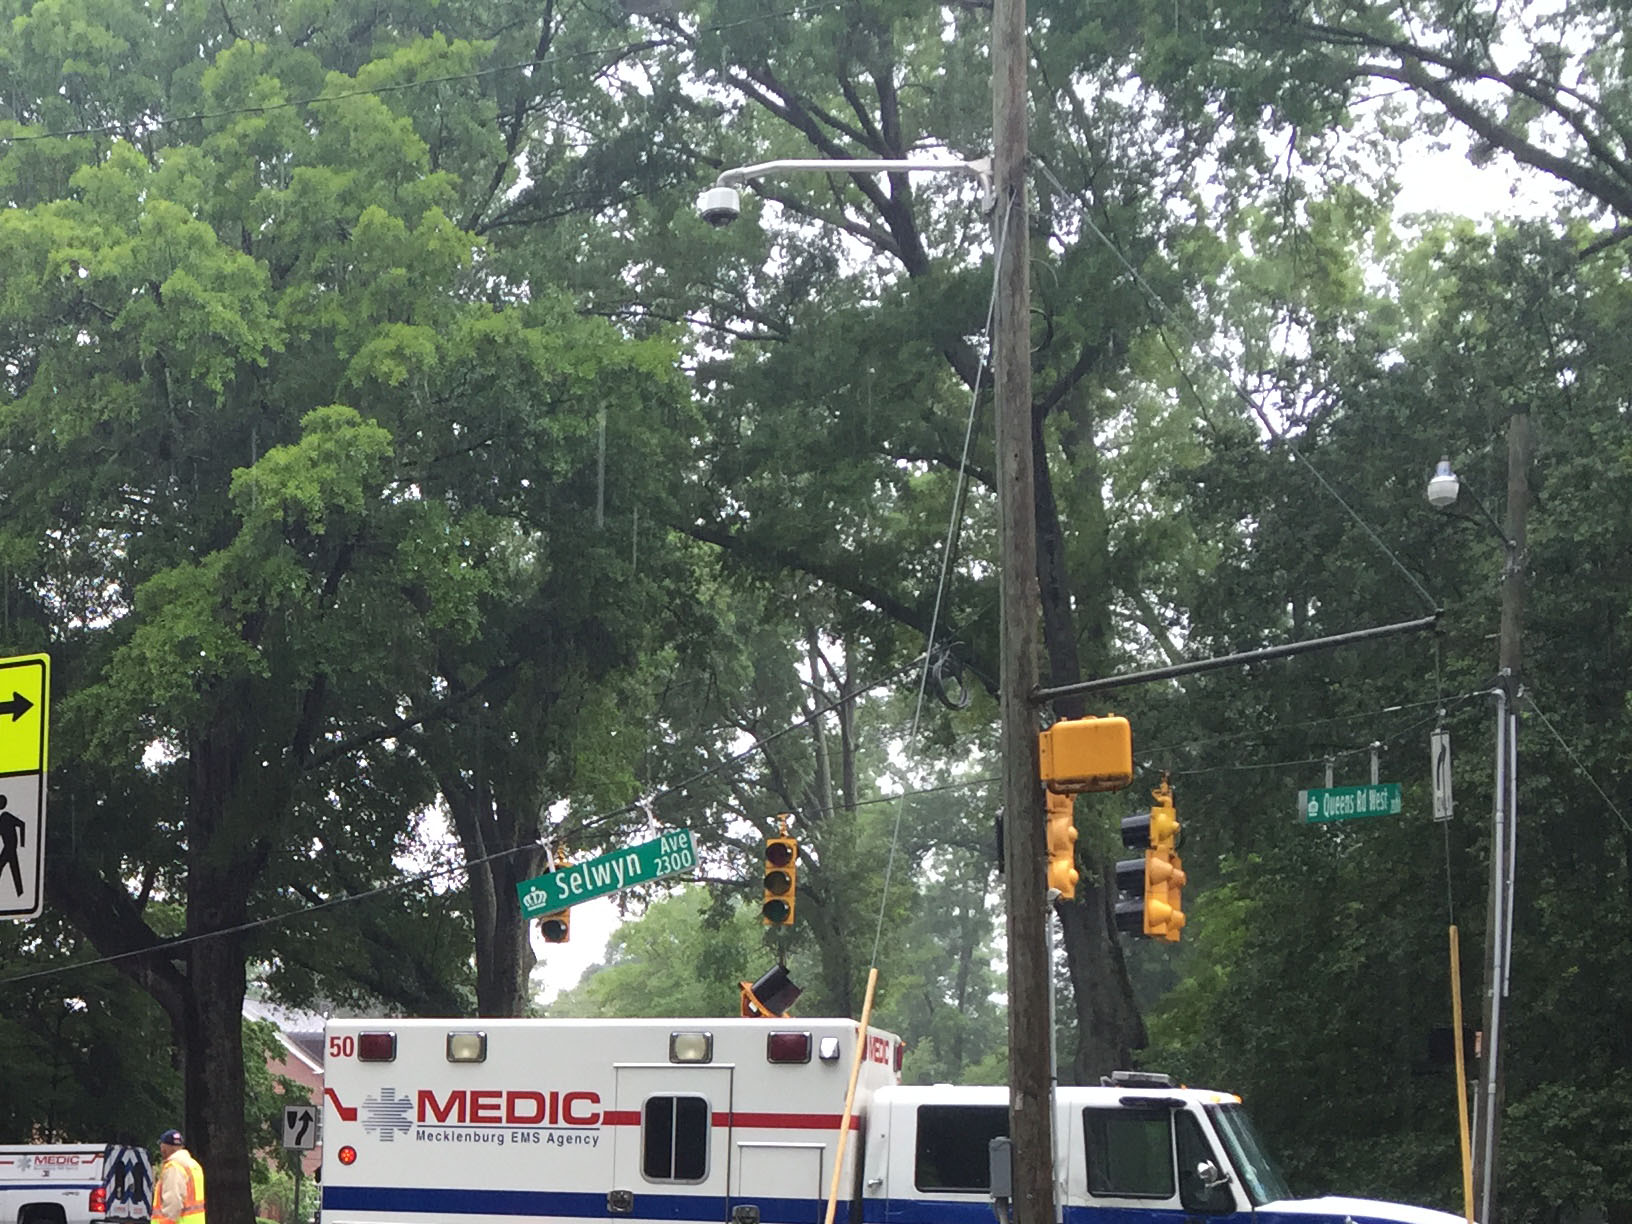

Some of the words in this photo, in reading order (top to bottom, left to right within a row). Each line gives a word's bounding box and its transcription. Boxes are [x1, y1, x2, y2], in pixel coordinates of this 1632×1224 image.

[1323, 791, 1355, 818] Queens
[1356, 789, 1367, 812] Rd
[1369, 787, 1388, 811] West
[555, 853, 642, 899] Selwyn
[660, 832, 688, 855] Ave
[654, 851, 692, 877] 2300
[329, 1036, 355, 1058] 50
[417, 1089, 601, 1125] MEDIC
[416, 1129, 504, 1146] Mecklenburg
[511, 1131, 541, 1143] EMS
[547, 1132, 599, 1147] Agency
[34, 1154, 80, 1165] MEDIC
